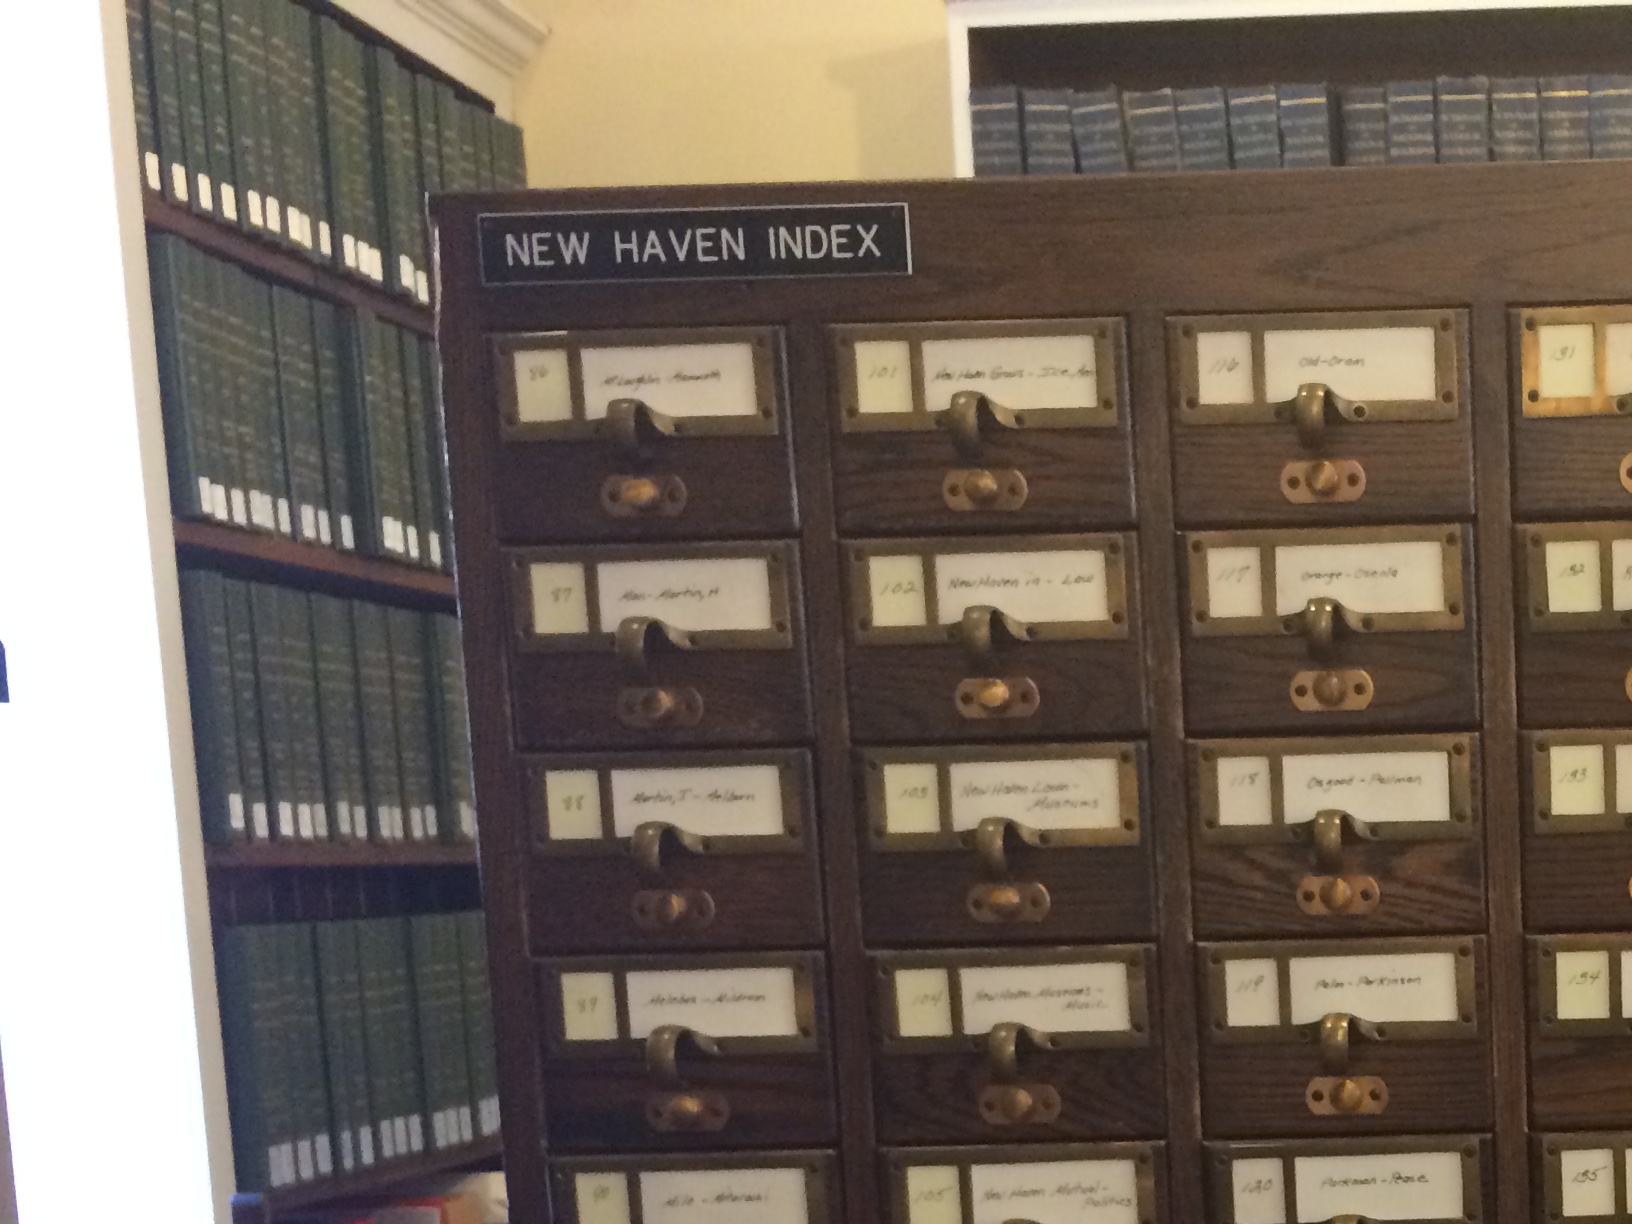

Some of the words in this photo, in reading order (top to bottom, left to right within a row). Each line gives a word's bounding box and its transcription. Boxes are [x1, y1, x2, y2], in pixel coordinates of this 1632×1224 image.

[506, 231, 591, 268] NEW
[614, 227, 747, 265] HAVEN
[769, 223, 881, 261] INDEX
[1551, 345, 1576, 362] 131
[868, 364, 900, 380] 101
[879, 578, 921, 598] 102
[947, 577, 977, 590] New
[973, 574, 1020, 588] Haven
[1561, 766, 1588, 783] 133
[958, 781, 990, 799] New
[1571, 967, 1604, 985] 134
